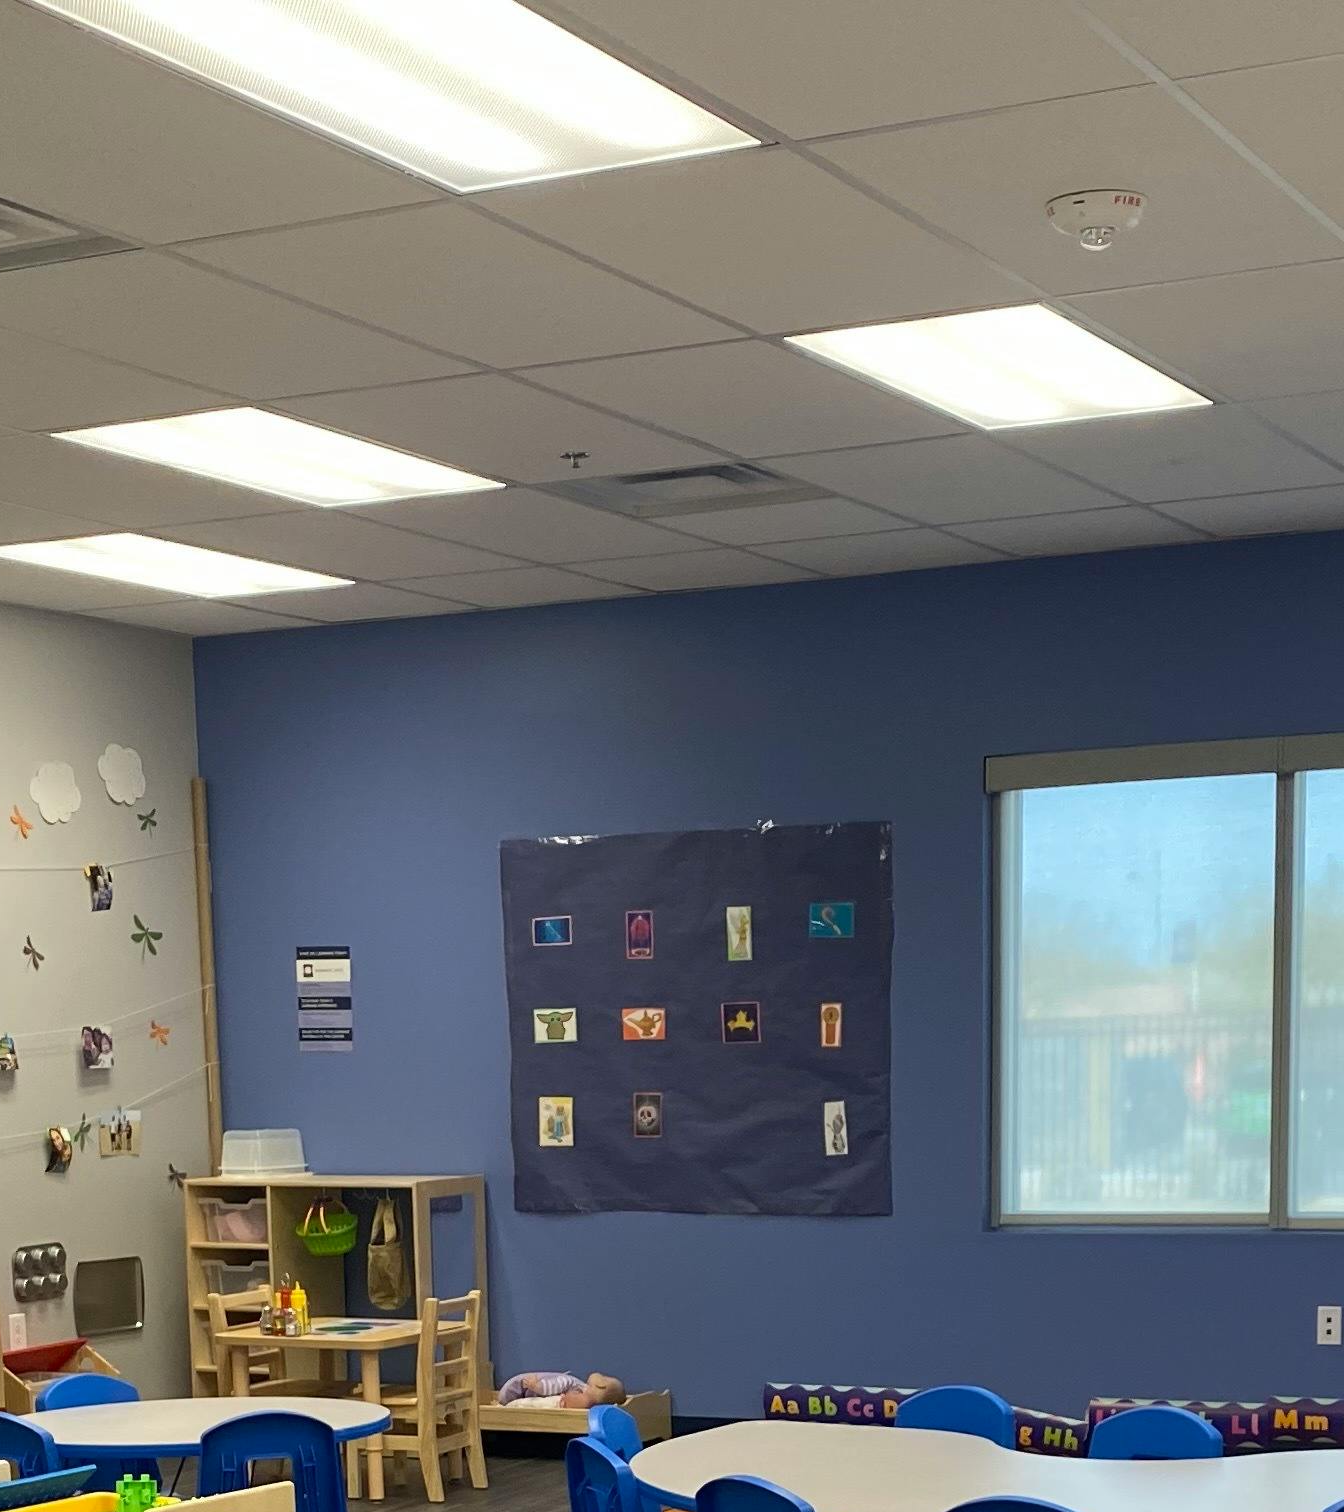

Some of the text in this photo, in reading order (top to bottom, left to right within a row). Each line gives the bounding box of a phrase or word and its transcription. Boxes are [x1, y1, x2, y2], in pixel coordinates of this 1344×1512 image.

[1114, 195, 1142, 207] FIRE
[769, 1395, 800, 1415] Aa
[808, 1396, 837, 1417] Bb
[846, 1398, 875, 1418] Cc
[1232, 1412, 1259, 1436] Ll
[1274, 1408, 1329, 1432] Mm
[1044, 1426, 1078, 1449] Hh
